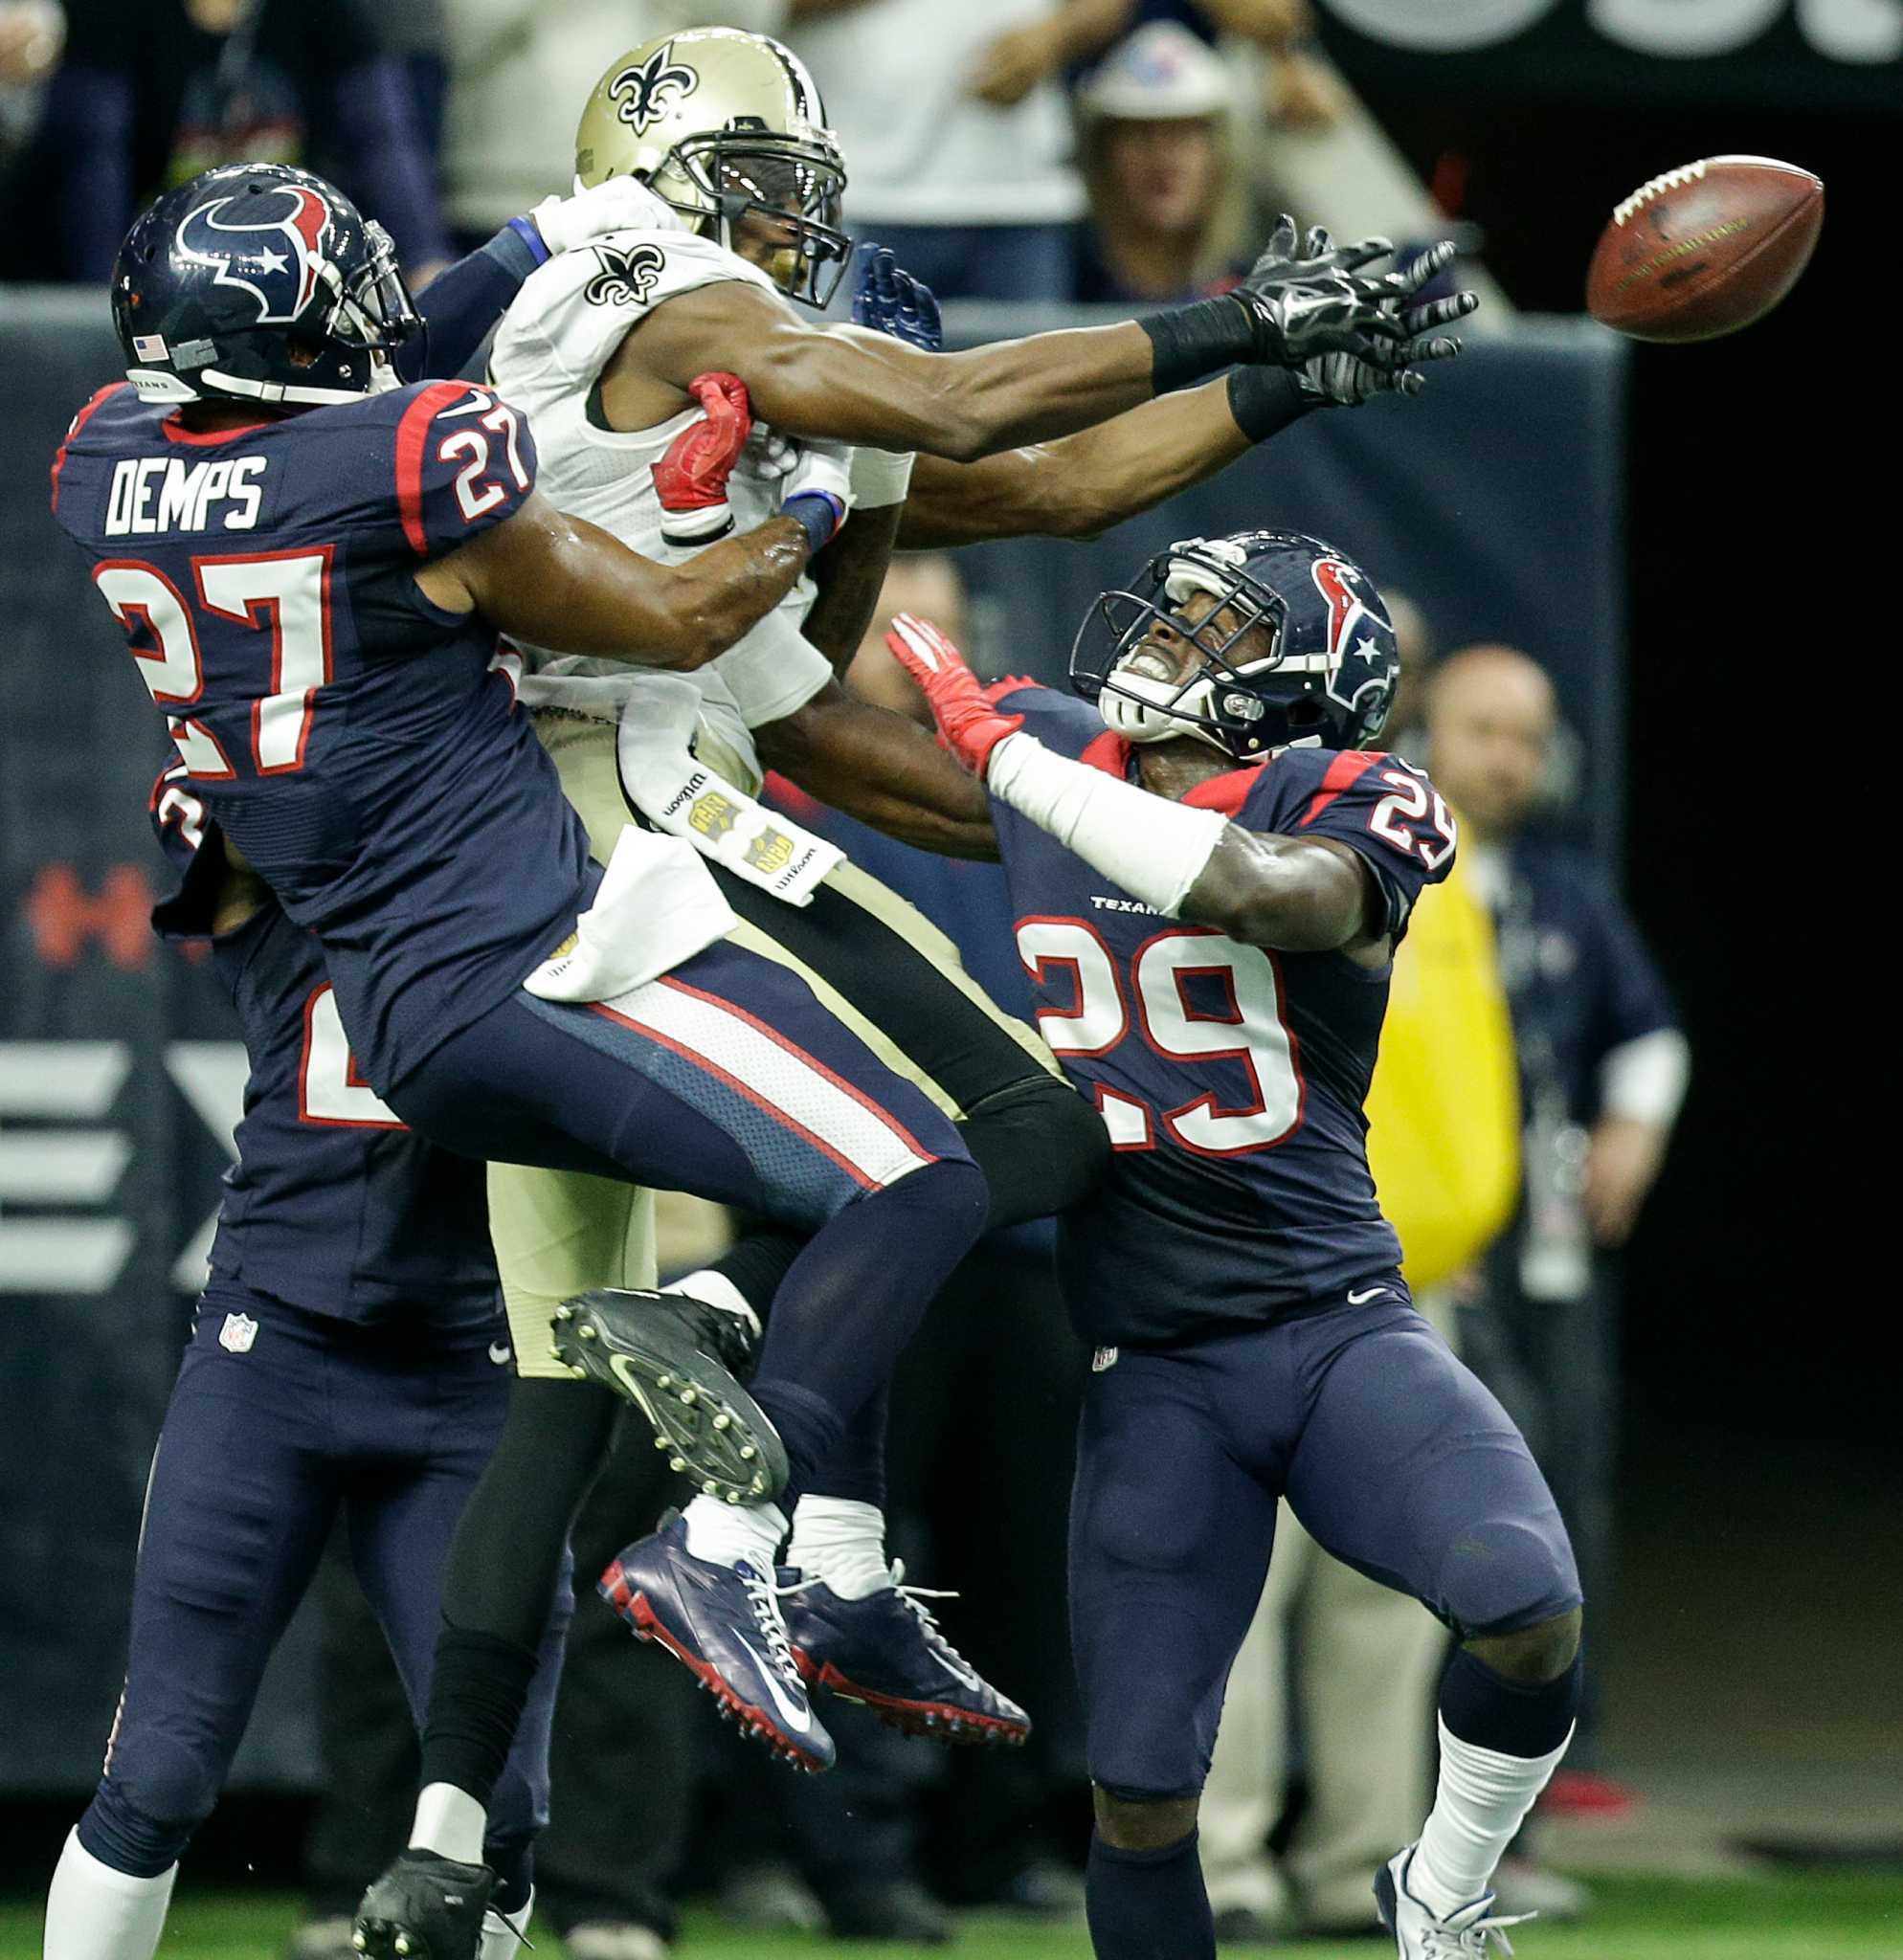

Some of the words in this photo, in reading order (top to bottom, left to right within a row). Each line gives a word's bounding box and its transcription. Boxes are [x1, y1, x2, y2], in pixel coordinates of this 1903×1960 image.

[105, 456, 267, 536] DEMPS
[437, 402, 529, 524] 27
[92, 544, 335, 779] 27
[662, 772, 708, 816] Wilson
[1366, 768, 1457, 873] 29
[774, 848, 817, 890] Wilson
[1090, 896, 1160, 916] TEXAN
[1013, 915, 1305, 1158] 29
